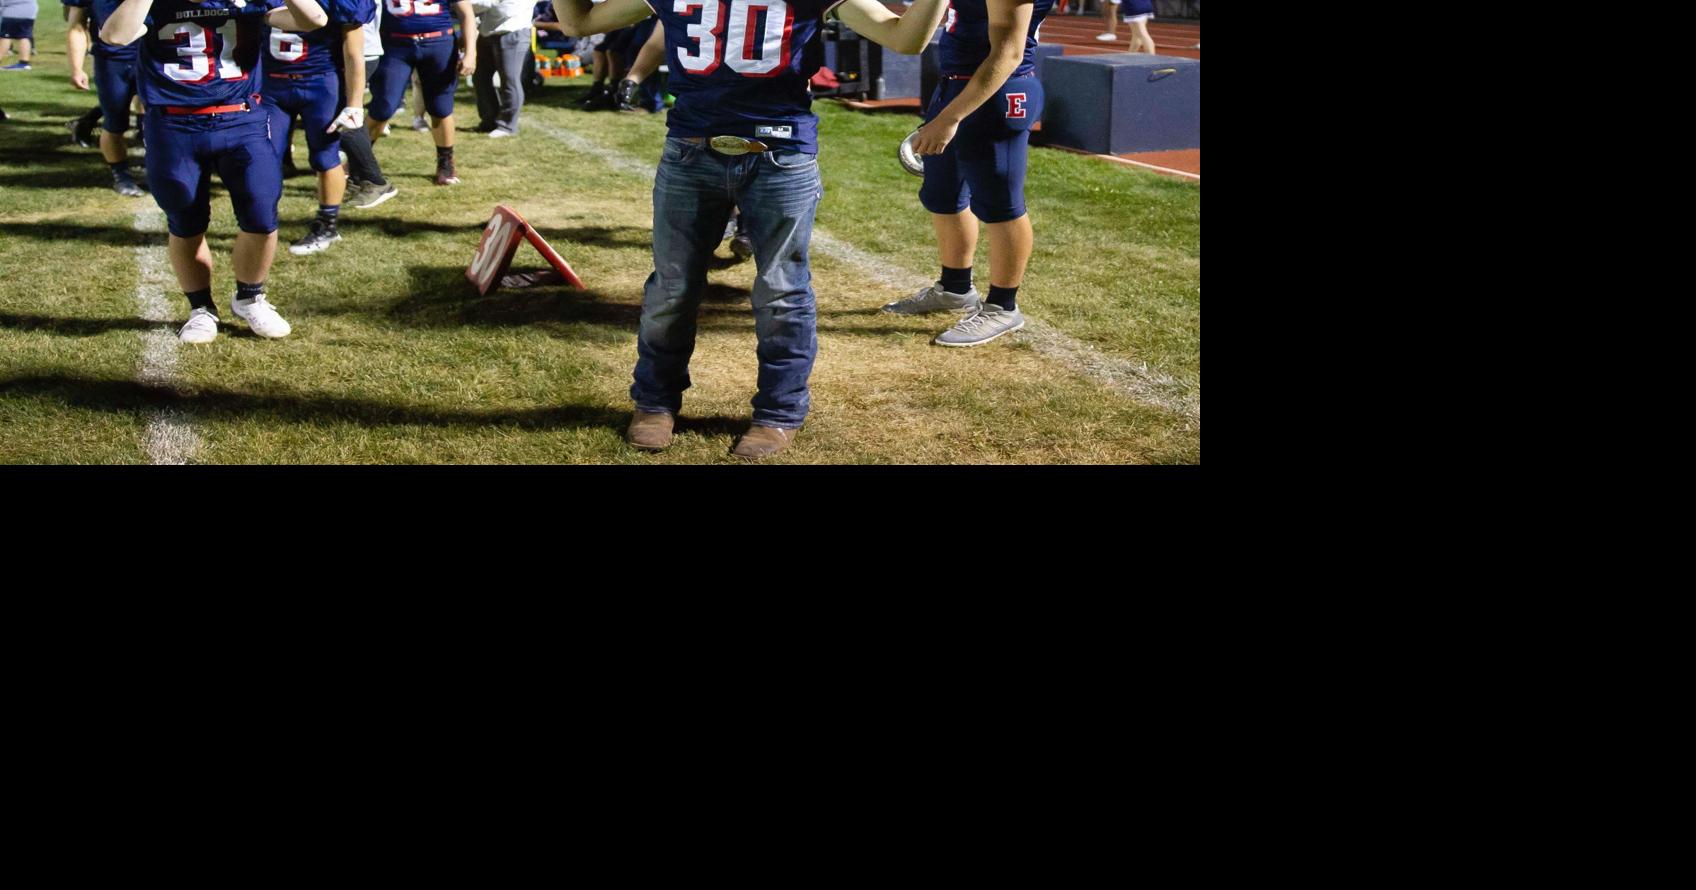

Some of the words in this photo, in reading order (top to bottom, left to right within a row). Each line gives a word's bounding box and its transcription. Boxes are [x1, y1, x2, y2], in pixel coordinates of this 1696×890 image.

[175, 9, 230, 19] BULLDOGS
[673, 0, 795, 77] 30
[158, 19, 248, 84] 31
[1005, 92, 1026, 118] E
[470, 213, 511, 285] 30
